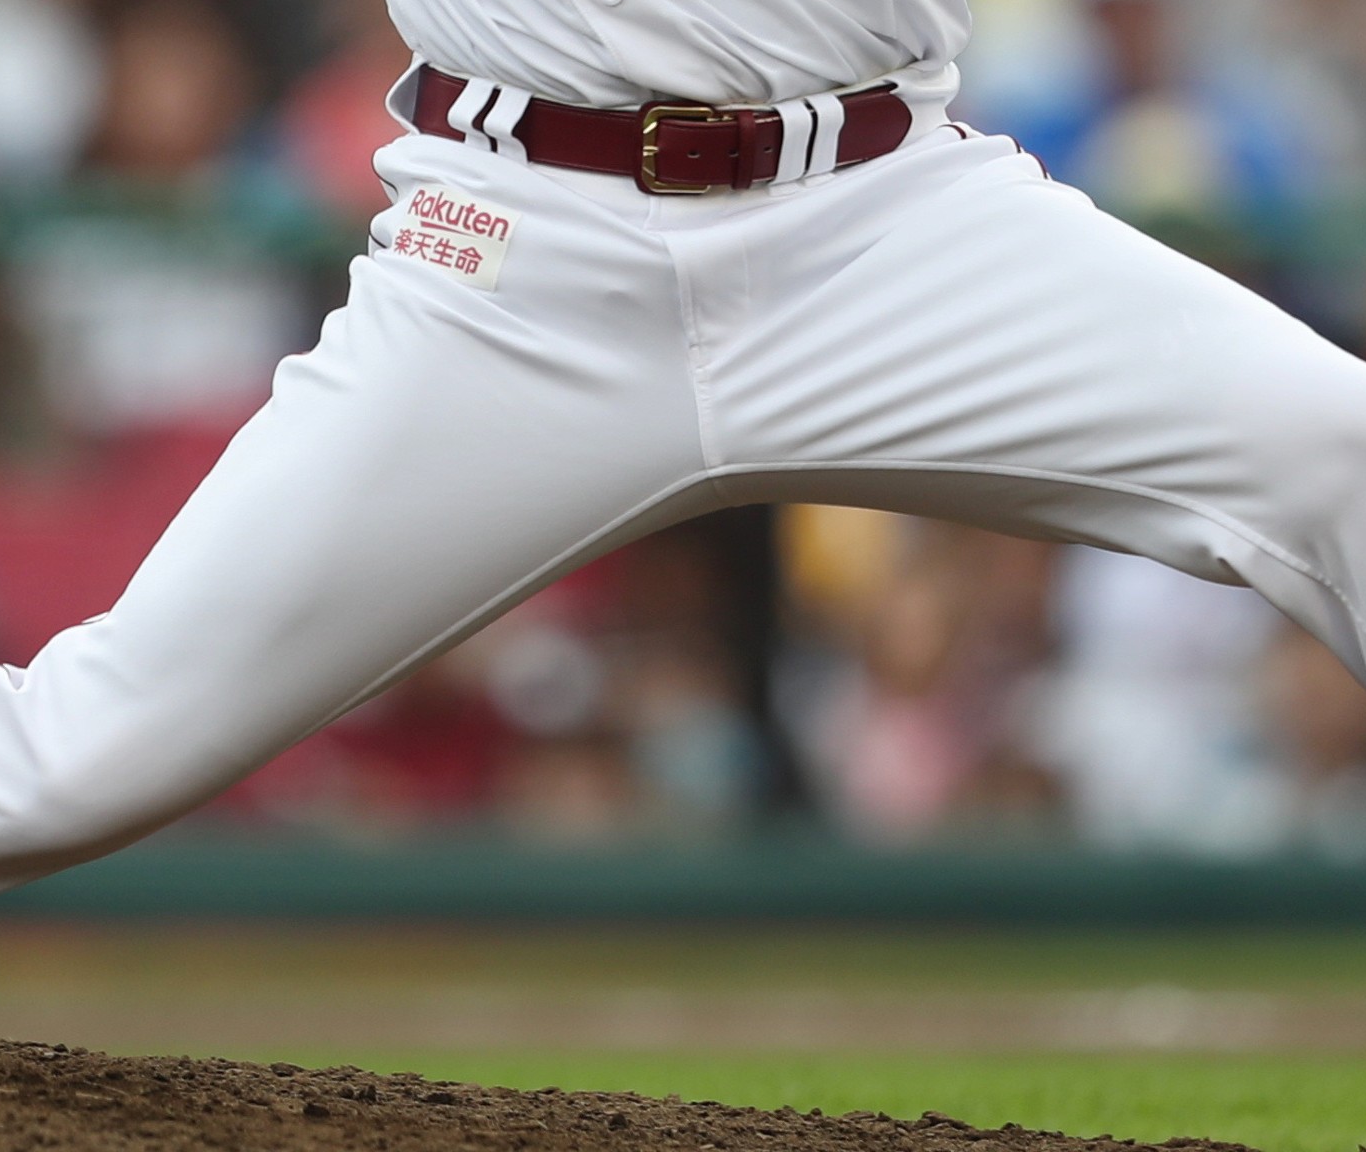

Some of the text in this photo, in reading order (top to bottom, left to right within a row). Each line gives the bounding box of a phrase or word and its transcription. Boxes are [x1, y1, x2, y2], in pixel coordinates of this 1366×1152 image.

[407, 189, 509, 241] Rakuten
[394, 228, 483, 275] 楽天生命
